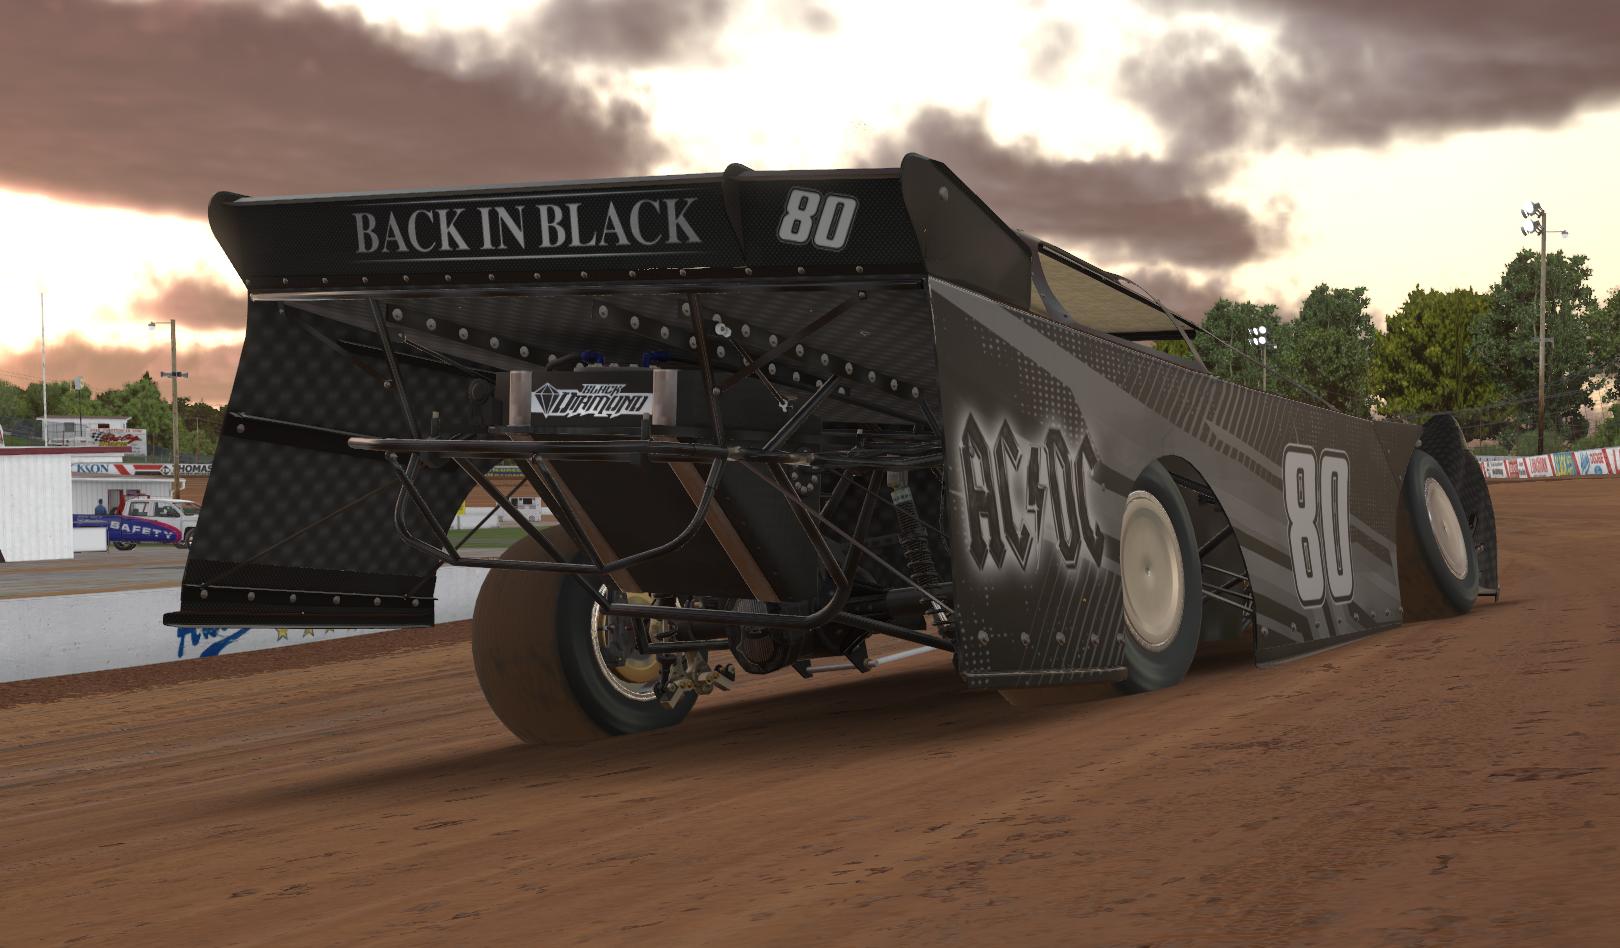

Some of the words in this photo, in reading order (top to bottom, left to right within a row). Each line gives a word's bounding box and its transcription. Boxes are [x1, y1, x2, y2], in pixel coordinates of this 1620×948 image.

[352, 208, 471, 254] BACK
[477, 205, 526, 250] IN
[536, 197, 702, 249] BLACK
[777, 187, 858, 252] 80
[580, 384, 623, 394] BLACK
[172, 463, 213, 473] HOMAS
[110, 521, 174, 539] SAFETY
[1282, 443, 1354, 609] 80
